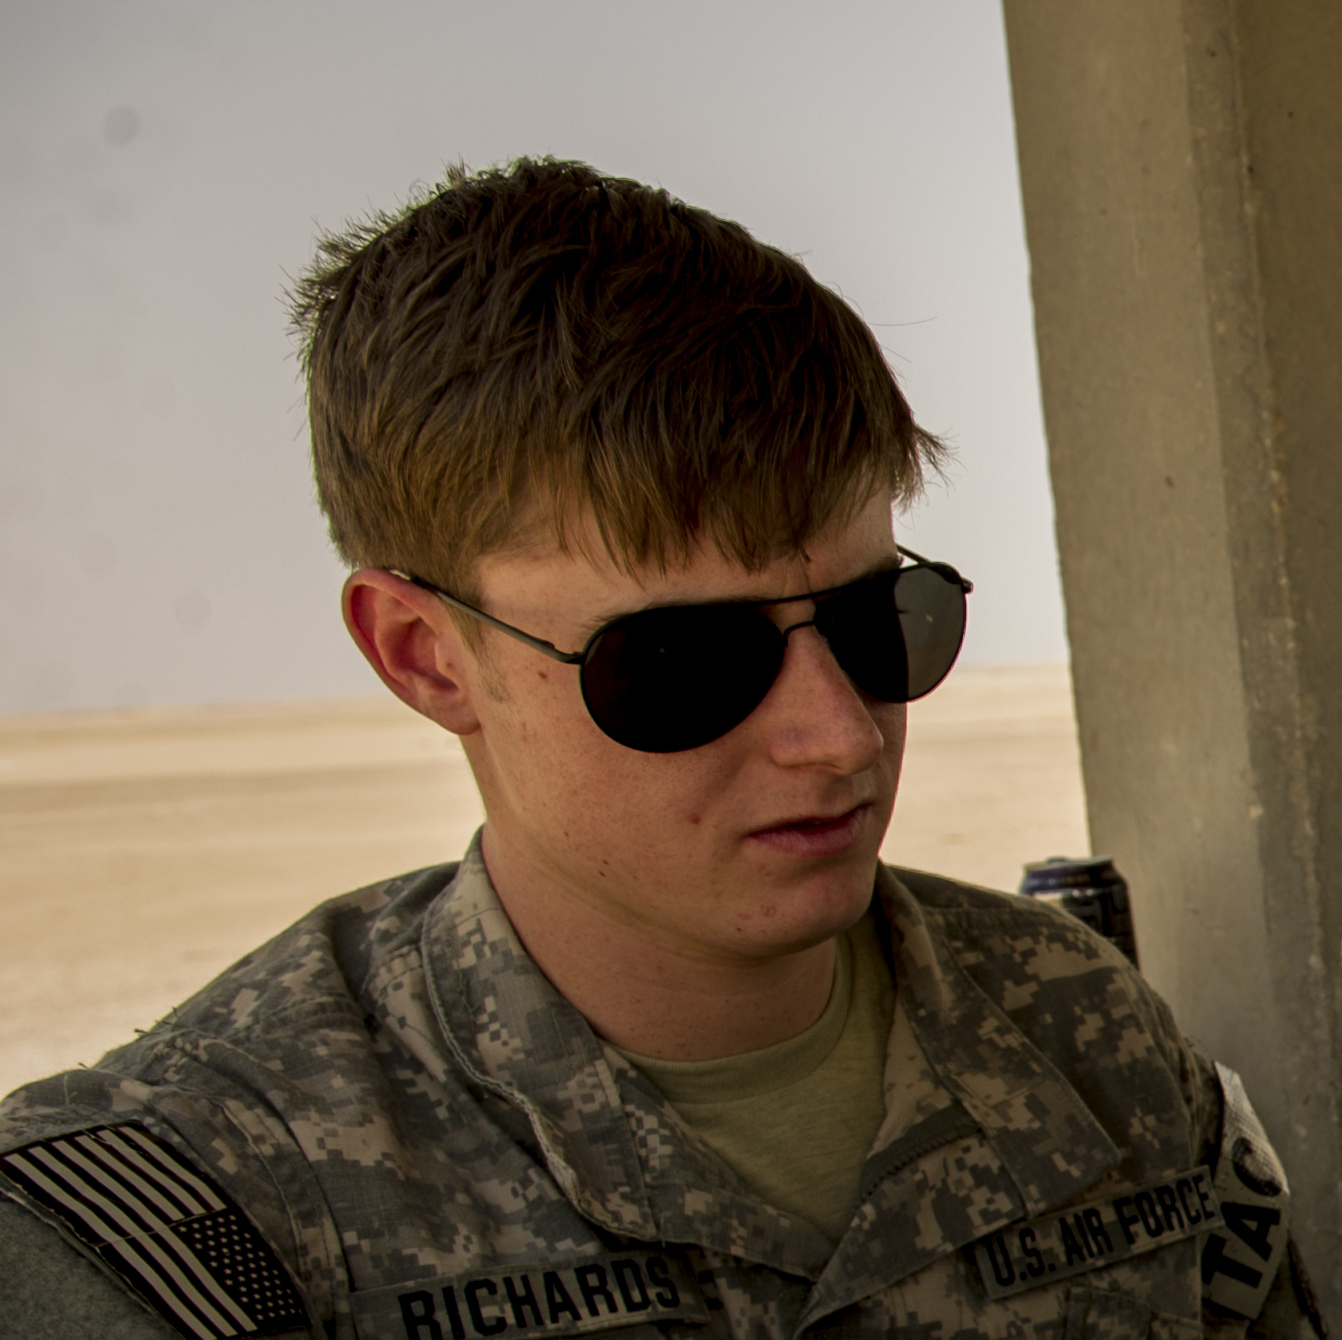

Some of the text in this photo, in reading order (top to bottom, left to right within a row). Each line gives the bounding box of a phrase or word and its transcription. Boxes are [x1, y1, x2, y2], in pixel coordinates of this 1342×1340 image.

[986, 1174, 1217, 1287] U.S. AIR FORCE
